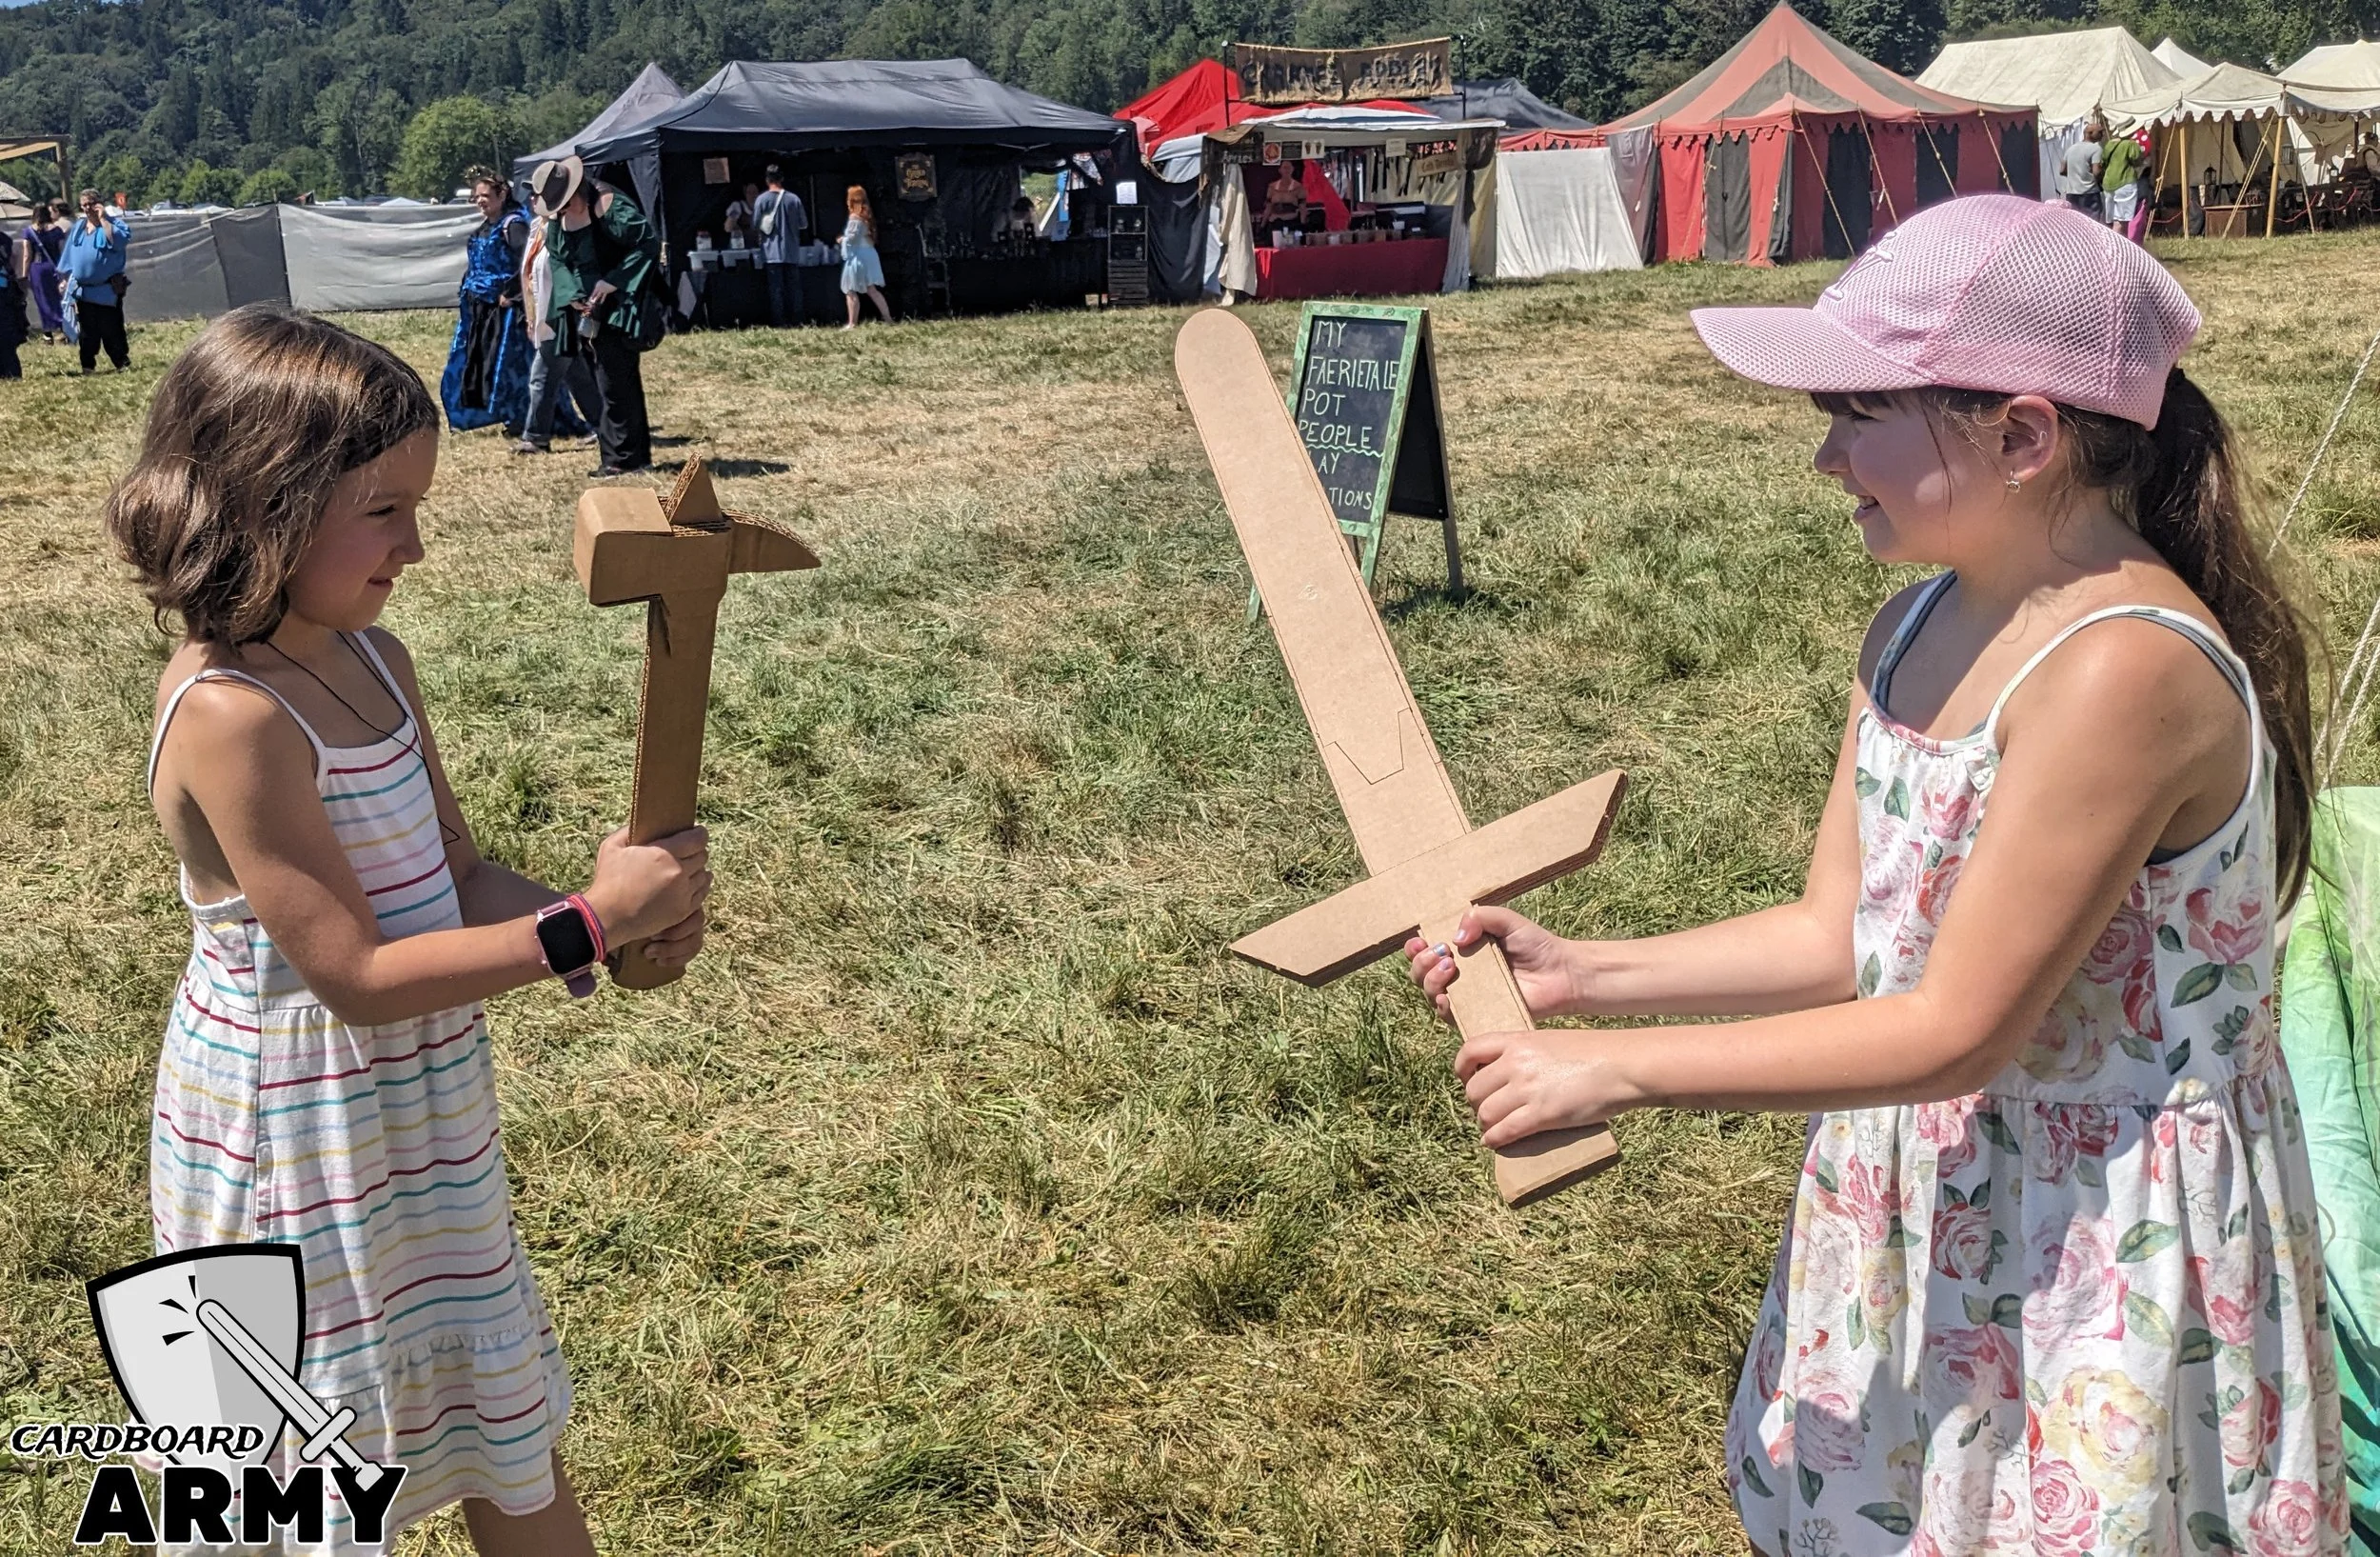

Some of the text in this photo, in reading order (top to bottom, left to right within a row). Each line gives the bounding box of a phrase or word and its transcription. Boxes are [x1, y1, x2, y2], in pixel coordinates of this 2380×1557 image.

[1316, 320, 1347, 348] MY
[1307, 355, 1399, 391] FAERIETALE
[1302, 388, 1346, 416] POT
[1299, 420, 1373, 449] PEOPLE
[1308, 450, 1339, 474] AY
[1329, 487, 1373, 510] TIONS
